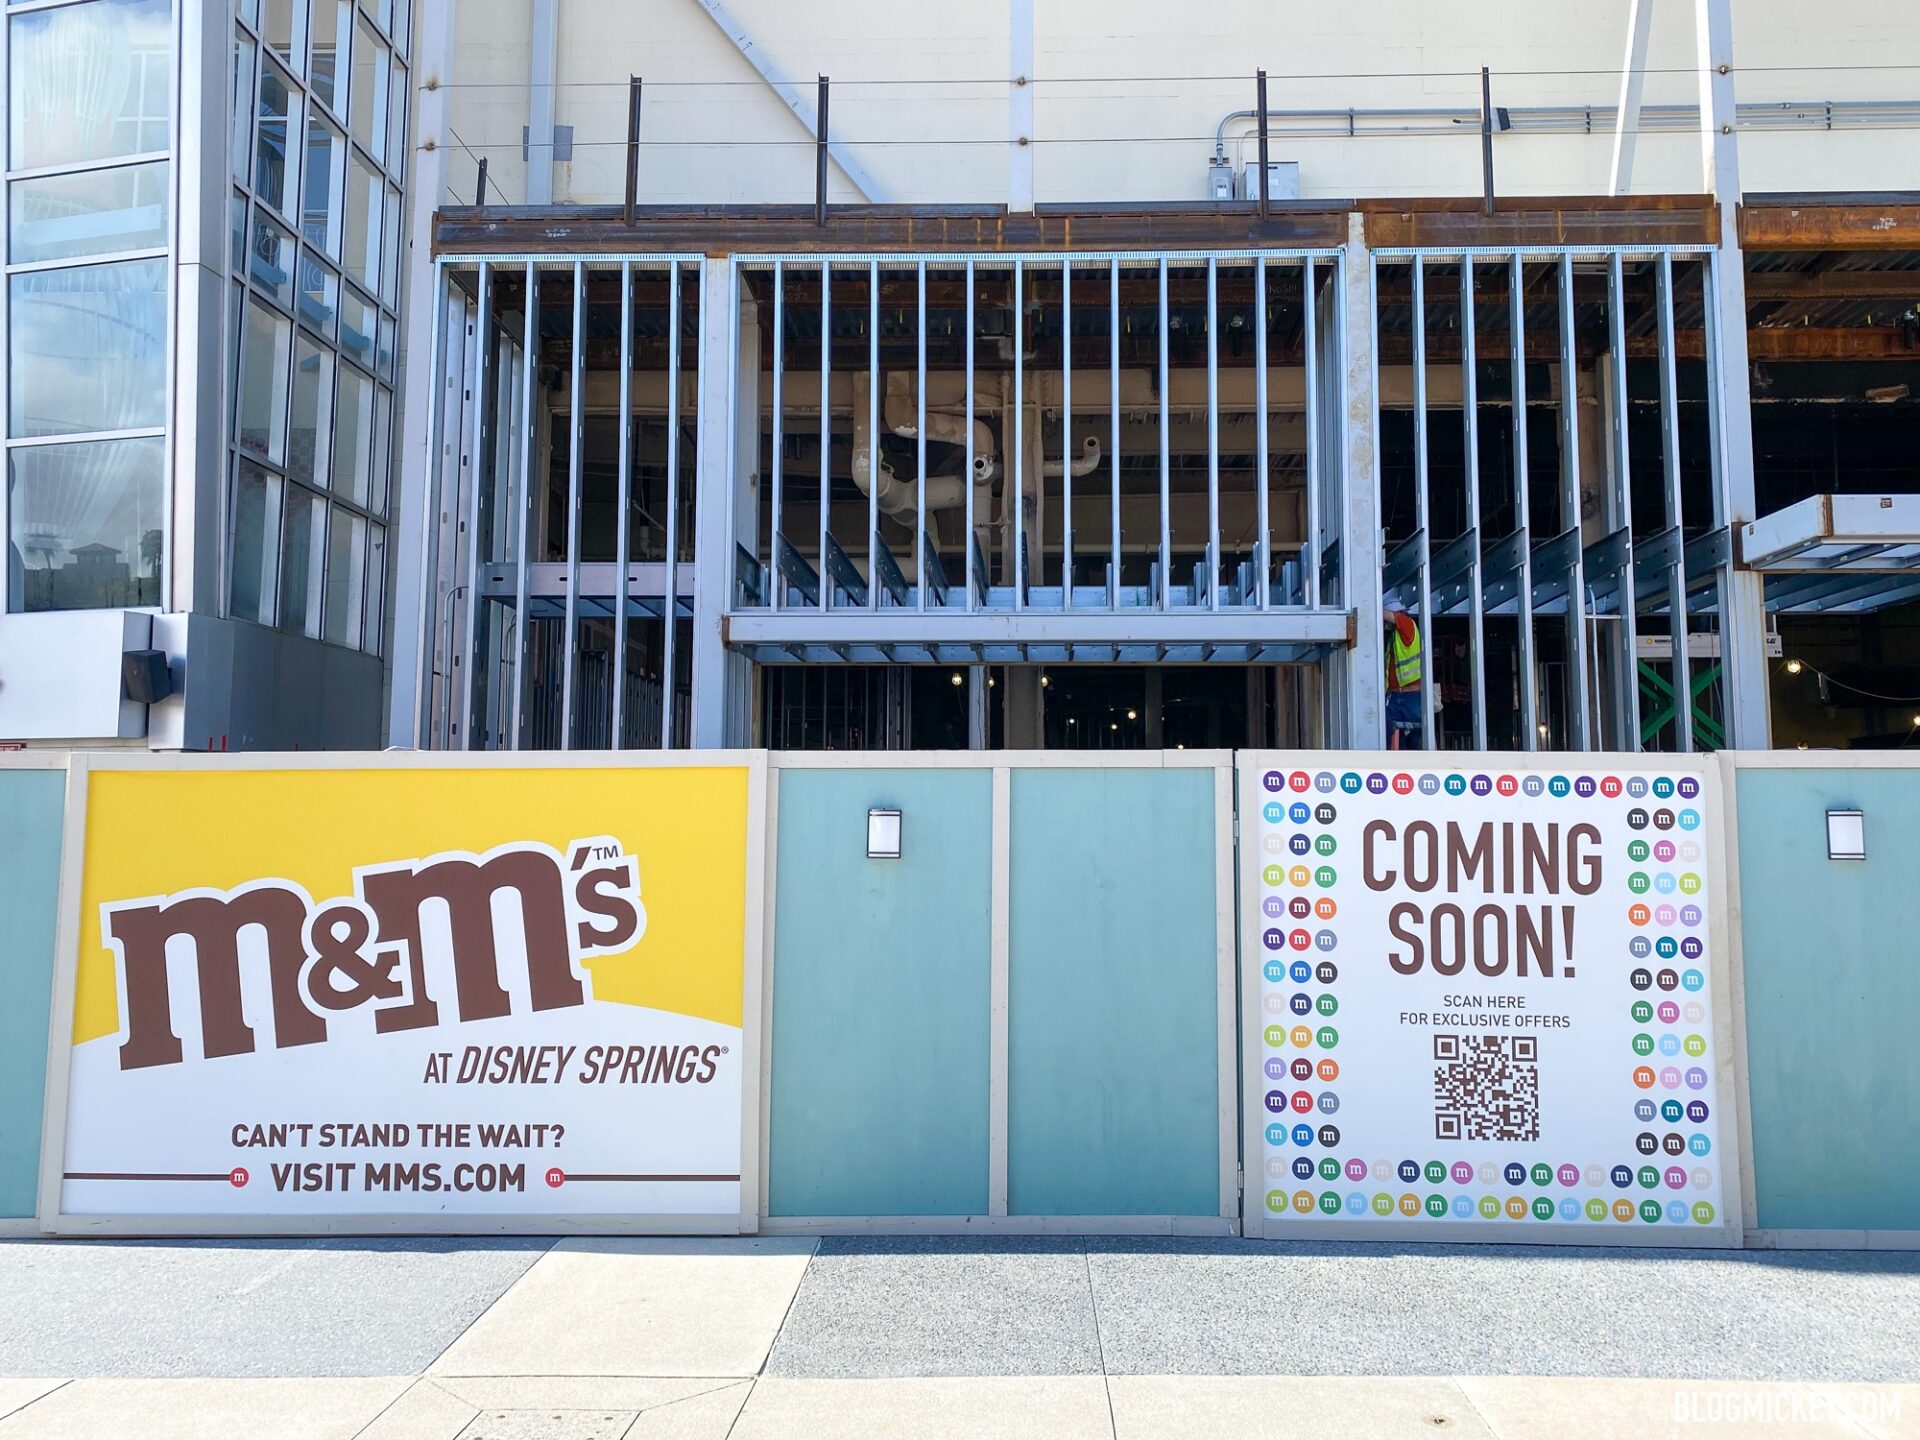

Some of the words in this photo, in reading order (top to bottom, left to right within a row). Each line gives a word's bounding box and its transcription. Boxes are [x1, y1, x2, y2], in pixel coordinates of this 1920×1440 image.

[1362, 819, 1602, 896] COMING
[1388, 902, 1576, 978] SOON!
[1443, 994, 1482, 1008] SCAN
[1487, 995, 1526, 1009] HERE
[1400, 1012, 1428, 1025] FOR
[1432, 1013, 1511, 1027] EXCLUSIVE
[1514, 1014, 1571, 1028] OFFERS
[423, 1053, 453, 1084] AT
[456, 1045, 577, 1084] DISNEY
[231, 1123, 314, 1148] CAN'T
[318, 1123, 410, 1148] STAND
[416, 1123, 471, 1148] THE
[477, 1124, 565, 1148] WAIT?
[270, 1162, 356, 1192] VISIT
[364, 1163, 526, 1192] MMS.COM
